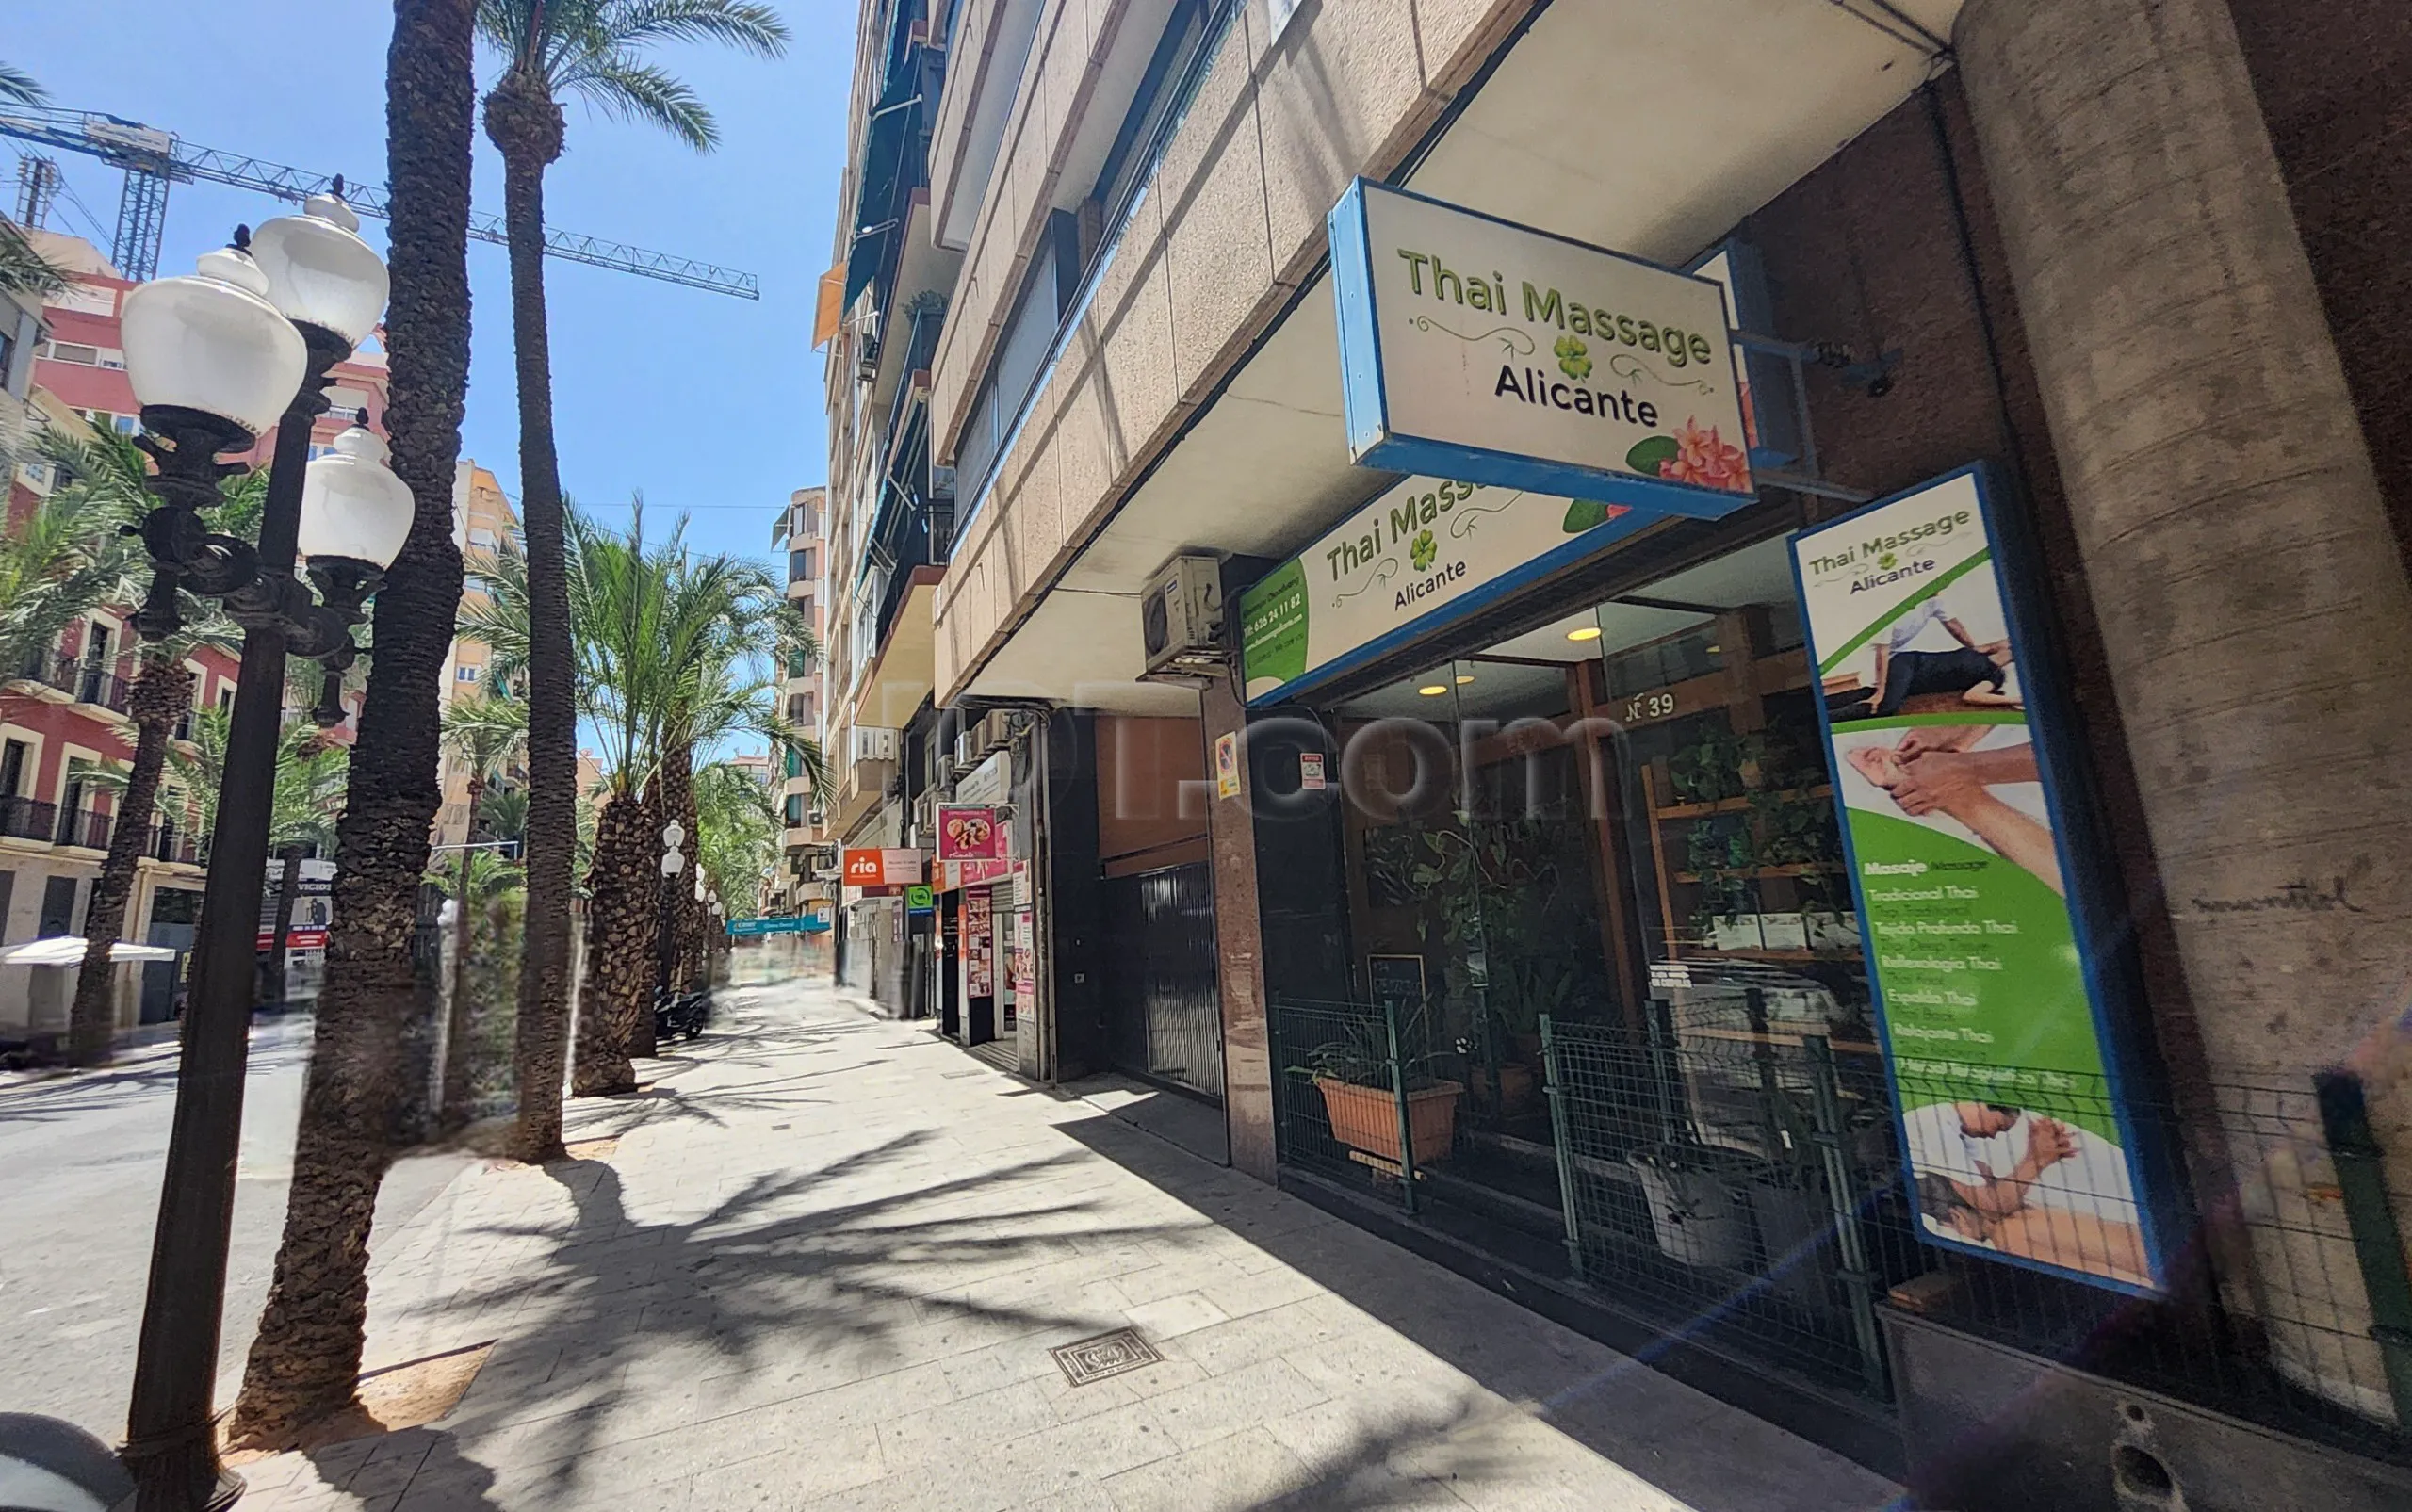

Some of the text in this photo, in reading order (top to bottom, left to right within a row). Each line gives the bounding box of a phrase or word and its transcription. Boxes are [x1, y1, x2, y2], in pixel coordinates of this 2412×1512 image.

[1397, 248, 1711, 368] Thai Massage
[1494, 365, 1658, 427] Alicante
[1327, 480, 1486, 581] Thai Mass
[1809, 510, 1970, 575] Thai Massage
[1393, 559, 1467, 611] Alicante
[1850, 559, 1935, 595] Alicante
[1254, 615, 1268, 632] 626
[1268, 608, 1279, 623] 24
[1279, 601, 1288, 616] 11
[1290, 593, 1301, 610] 82
[1649, 693, 1674, 717] 39
[850, 856, 877, 874] ria
[1865, 859, 1928, 877] Masaje
[1944, 885, 1979, 899] Thai
[1982, 919, 2019, 934] Thai
[1966, 955, 2003, 970] Thai
[1944, 990, 1978, 1006] Thai
[1959, 1027, 1995, 1043] Thai
